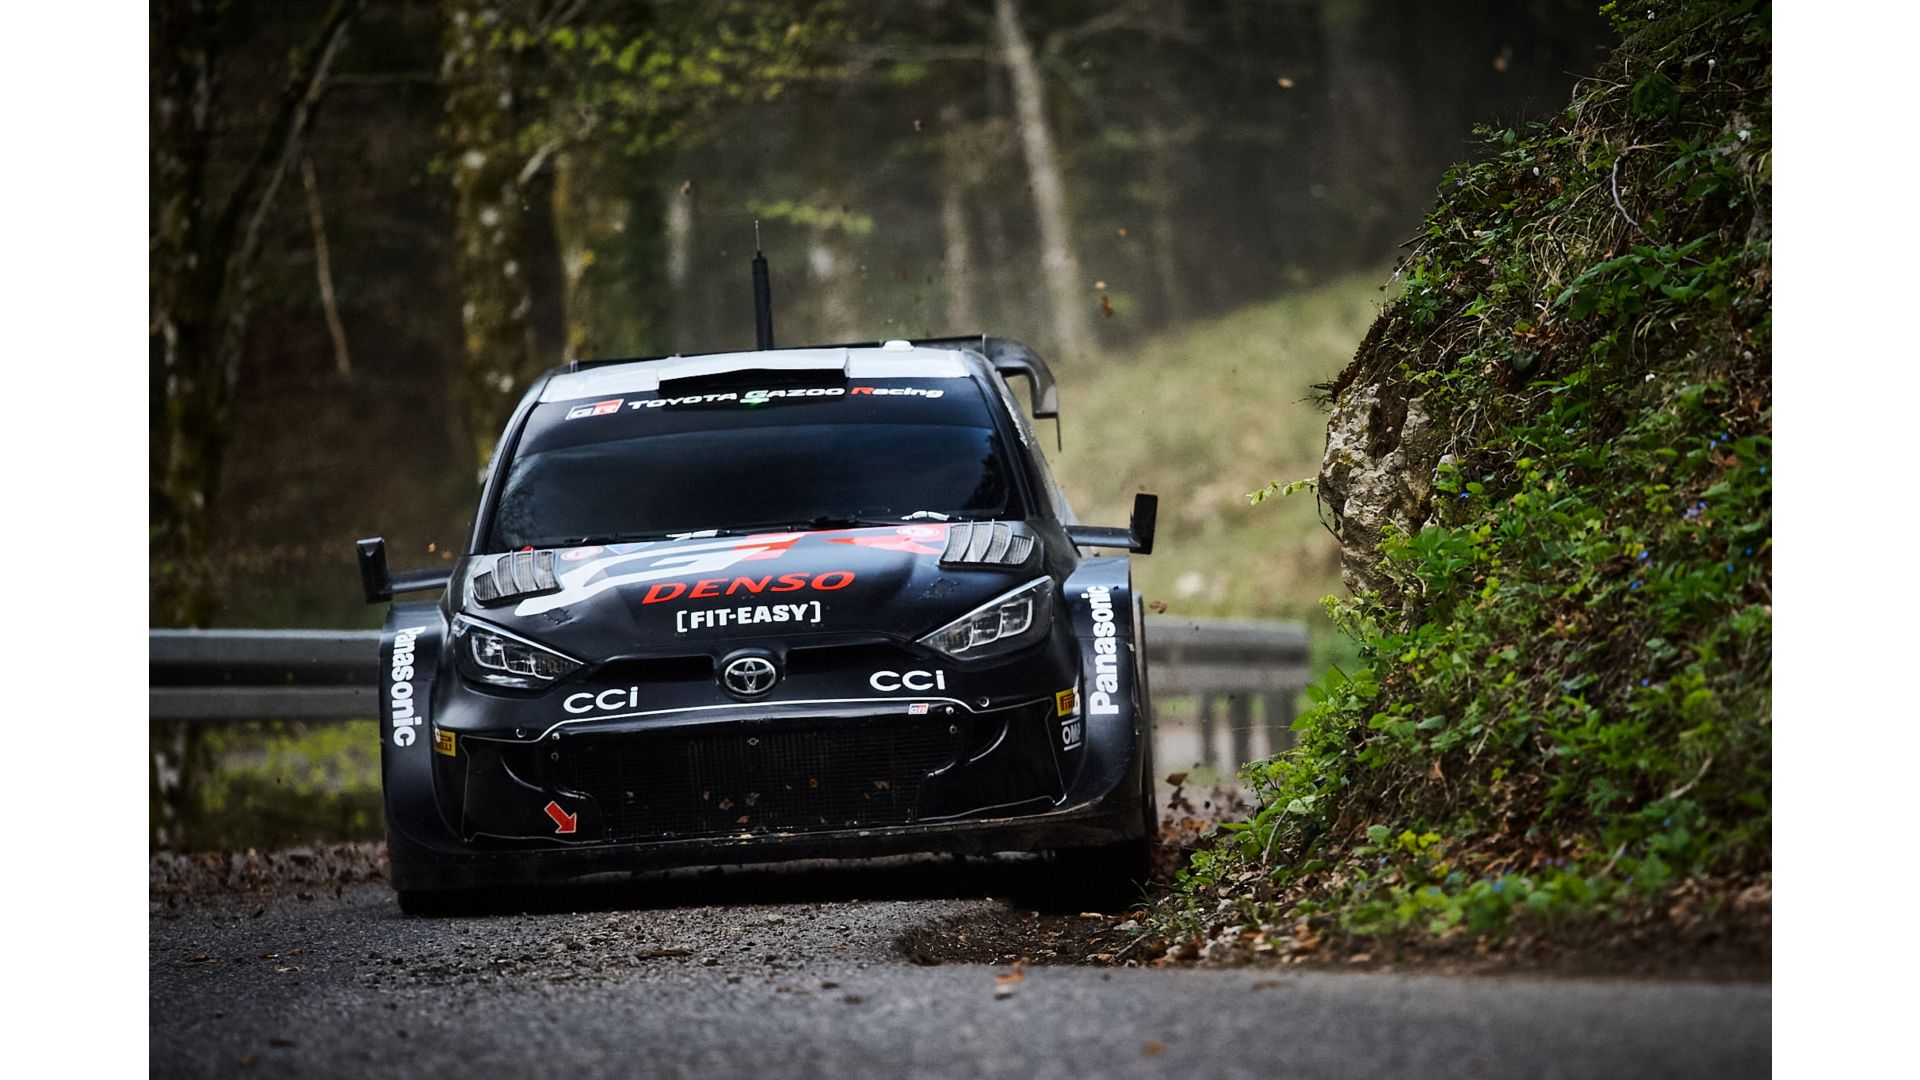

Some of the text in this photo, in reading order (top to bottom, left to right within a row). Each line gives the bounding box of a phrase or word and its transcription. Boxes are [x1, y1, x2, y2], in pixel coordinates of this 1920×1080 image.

[566, 386, 945, 420] GR TOYOTA GAZOO Racing
[641, 571, 856, 605] DENSO
[389, 625, 427, 748] Panasonic
[1080, 585, 1120, 715] Panasonic
